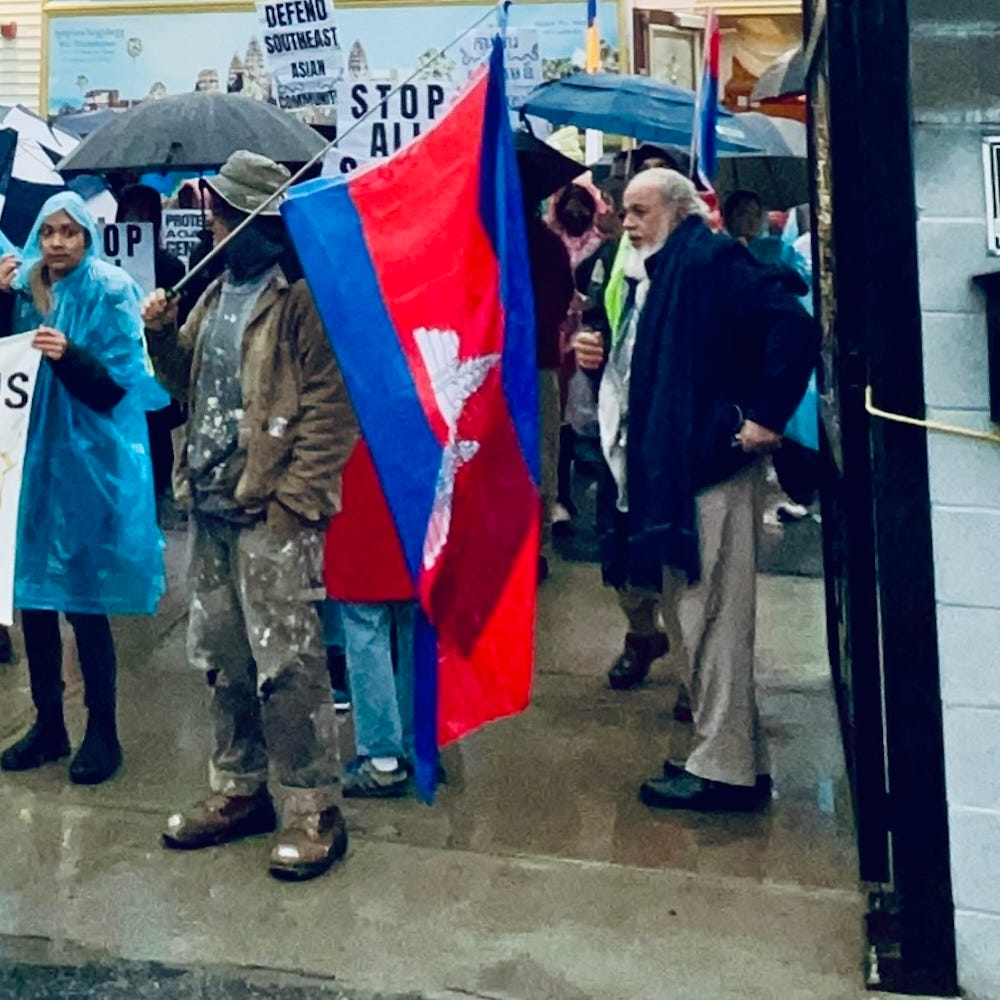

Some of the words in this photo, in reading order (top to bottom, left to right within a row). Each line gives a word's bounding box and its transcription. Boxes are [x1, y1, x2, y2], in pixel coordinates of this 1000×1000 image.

[264, 27, 339, 54] SOUTHEAST
[291, 60, 326, 78] ASIAN
[351, 83, 445, 119] STOP
